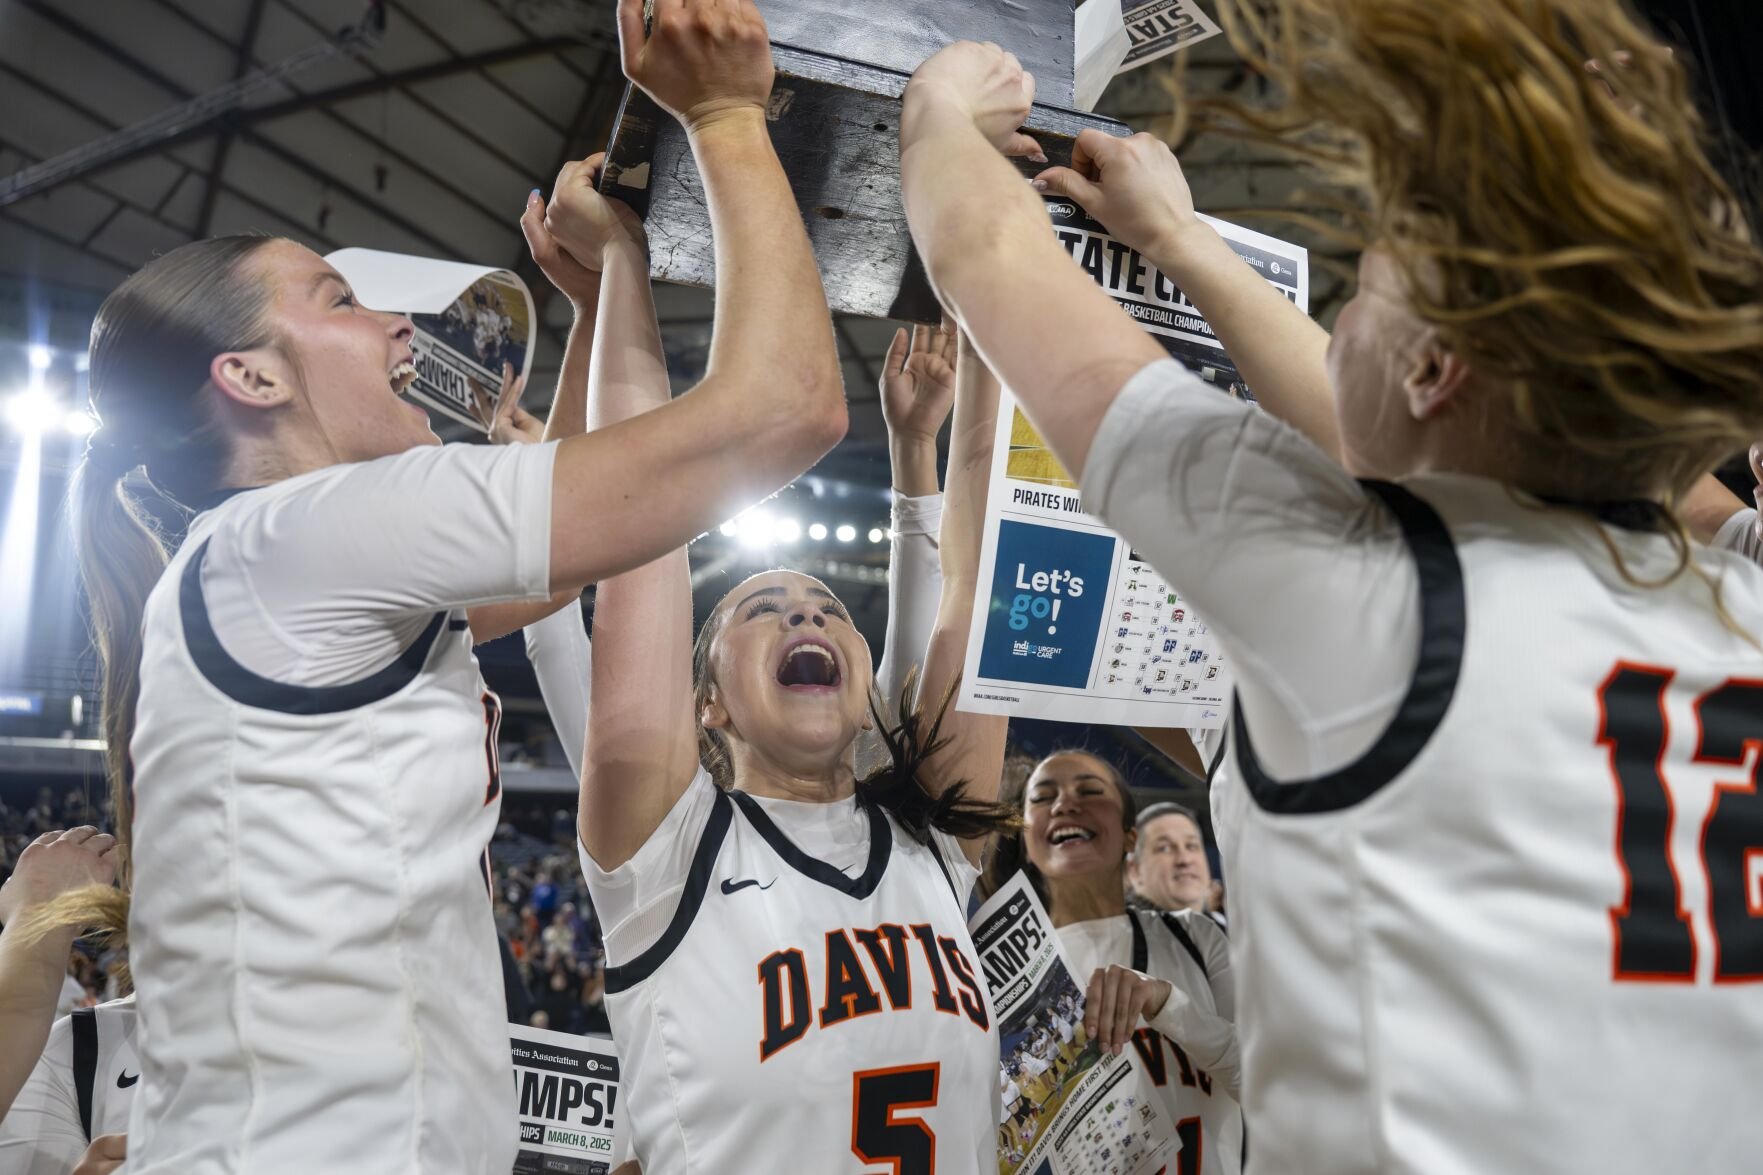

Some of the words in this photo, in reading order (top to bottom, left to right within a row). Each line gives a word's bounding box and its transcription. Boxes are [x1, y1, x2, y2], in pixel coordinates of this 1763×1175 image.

[1125, 5, 1194, 46] STAT
[1055, 231, 1146, 296] TATE
[1124, 302, 1173, 325] BASKETBALL
[1174, 315, 1215, 335] CHAMPIO
[415, 354, 465, 401] CHAMP
[1013, 488, 1060, 509] PIRATES
[1008, 594, 1061, 635] go!
[1117, 627, 1128, 637] GP
[1037, 651, 1053, 659] CARE
[1038, 645, 1062, 655] URGENT
[1163, 639, 1177, 653] GP
[1189, 649, 1203, 663] GP
[1594, 659, 1763, 985] 12
[975, 914, 1007, 945] Association
[981, 908, 1046, 996] AMPS!
[757, 923, 990, 1064] DAVIS
[992, 977, 1029, 1015] MPIONSHIPS
[511, 1047, 530, 1059] ities
[531, 1050, 579, 1066] Association
[1131, 1027, 1212, 1096] VI
[513, 1068, 617, 1129] MPS!
[851, 1061, 940, 1175] 5
[1036, 1130, 1052, 1155] DAVIS
[1051, 1104, 1070, 1133] BRINGS
[1069, 1083, 1085, 1107] HOME
[1085, 1065, 1101, 1087] FIRST
[547, 1130, 579, 1146] MARCH
[580, 1135, 588, 1148] 8,
[590, 1136, 611, 1151] 2025
